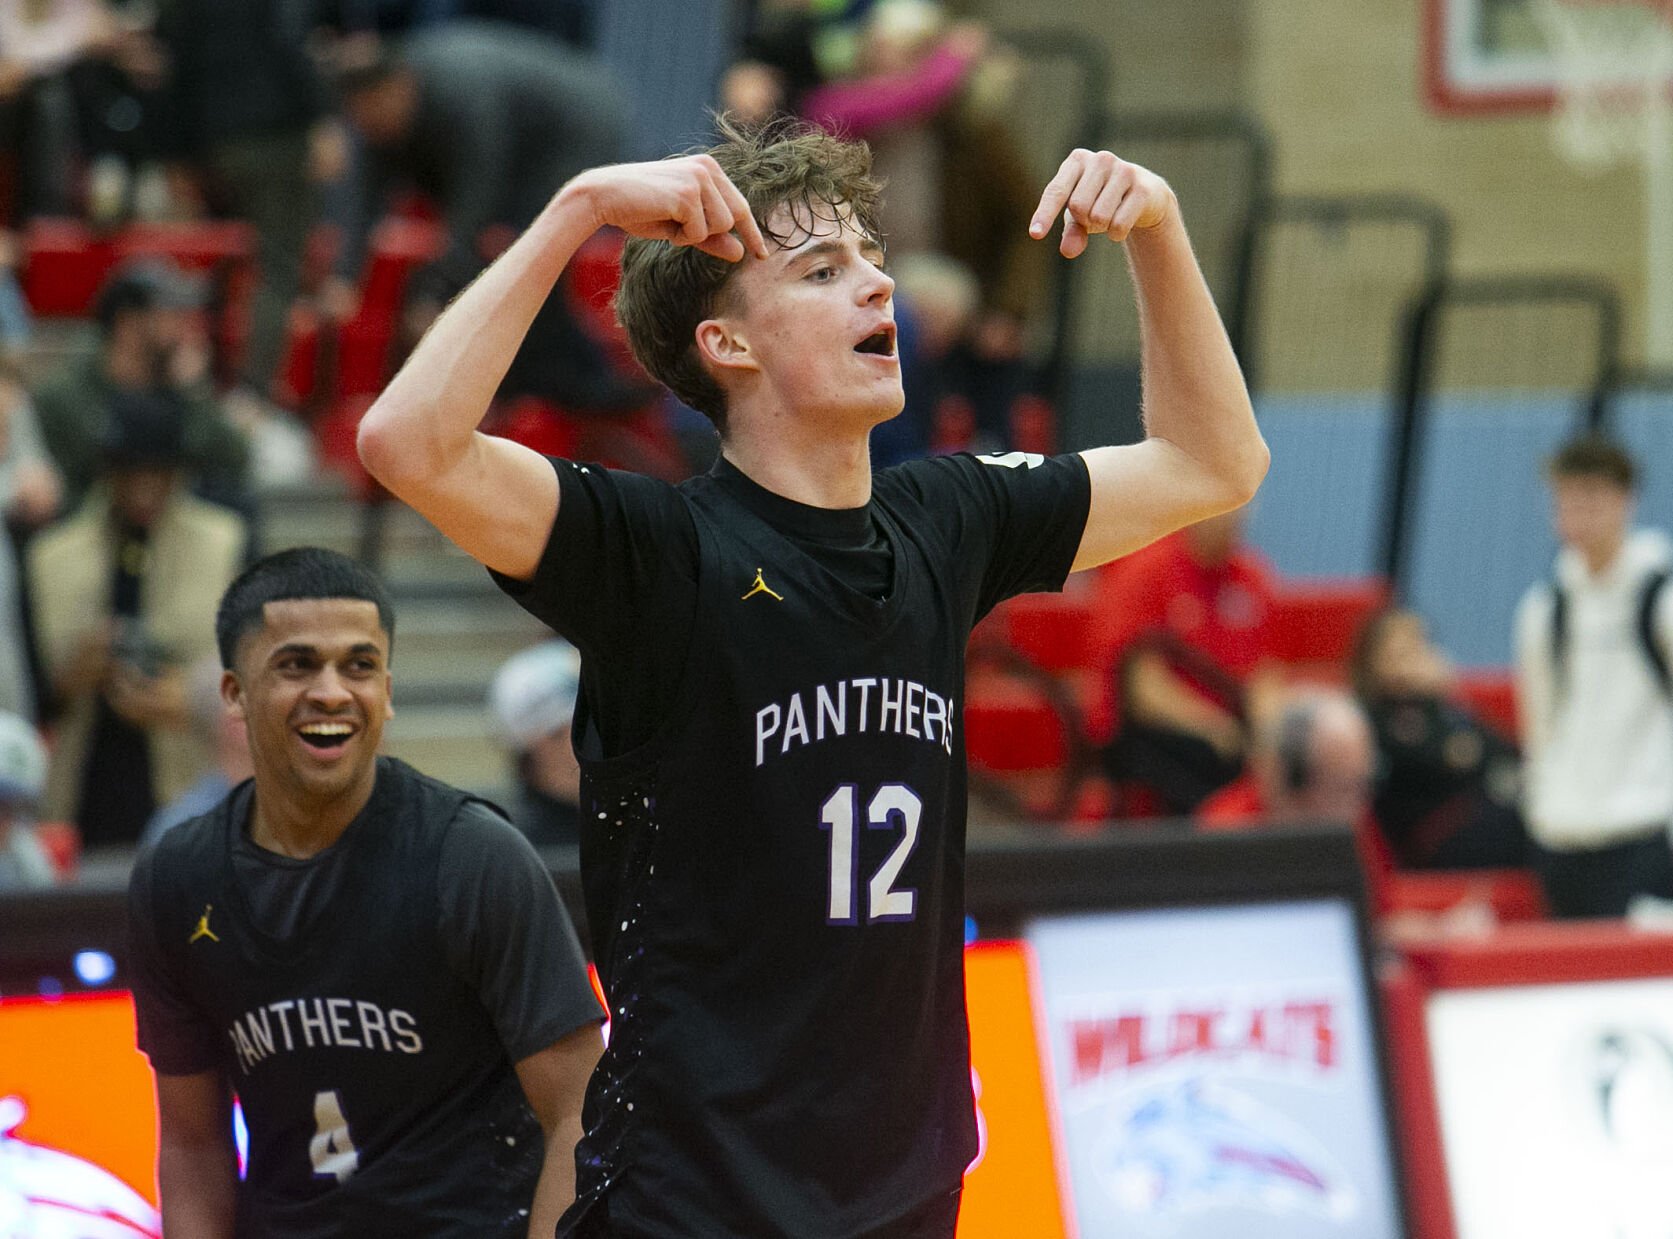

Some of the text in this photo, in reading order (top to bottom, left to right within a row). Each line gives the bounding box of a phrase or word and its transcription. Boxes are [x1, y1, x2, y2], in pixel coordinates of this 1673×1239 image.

[756, 677, 954, 767] PANTHERS
[819, 783, 923, 925] 12
[308, 1090, 359, 1184] 4
